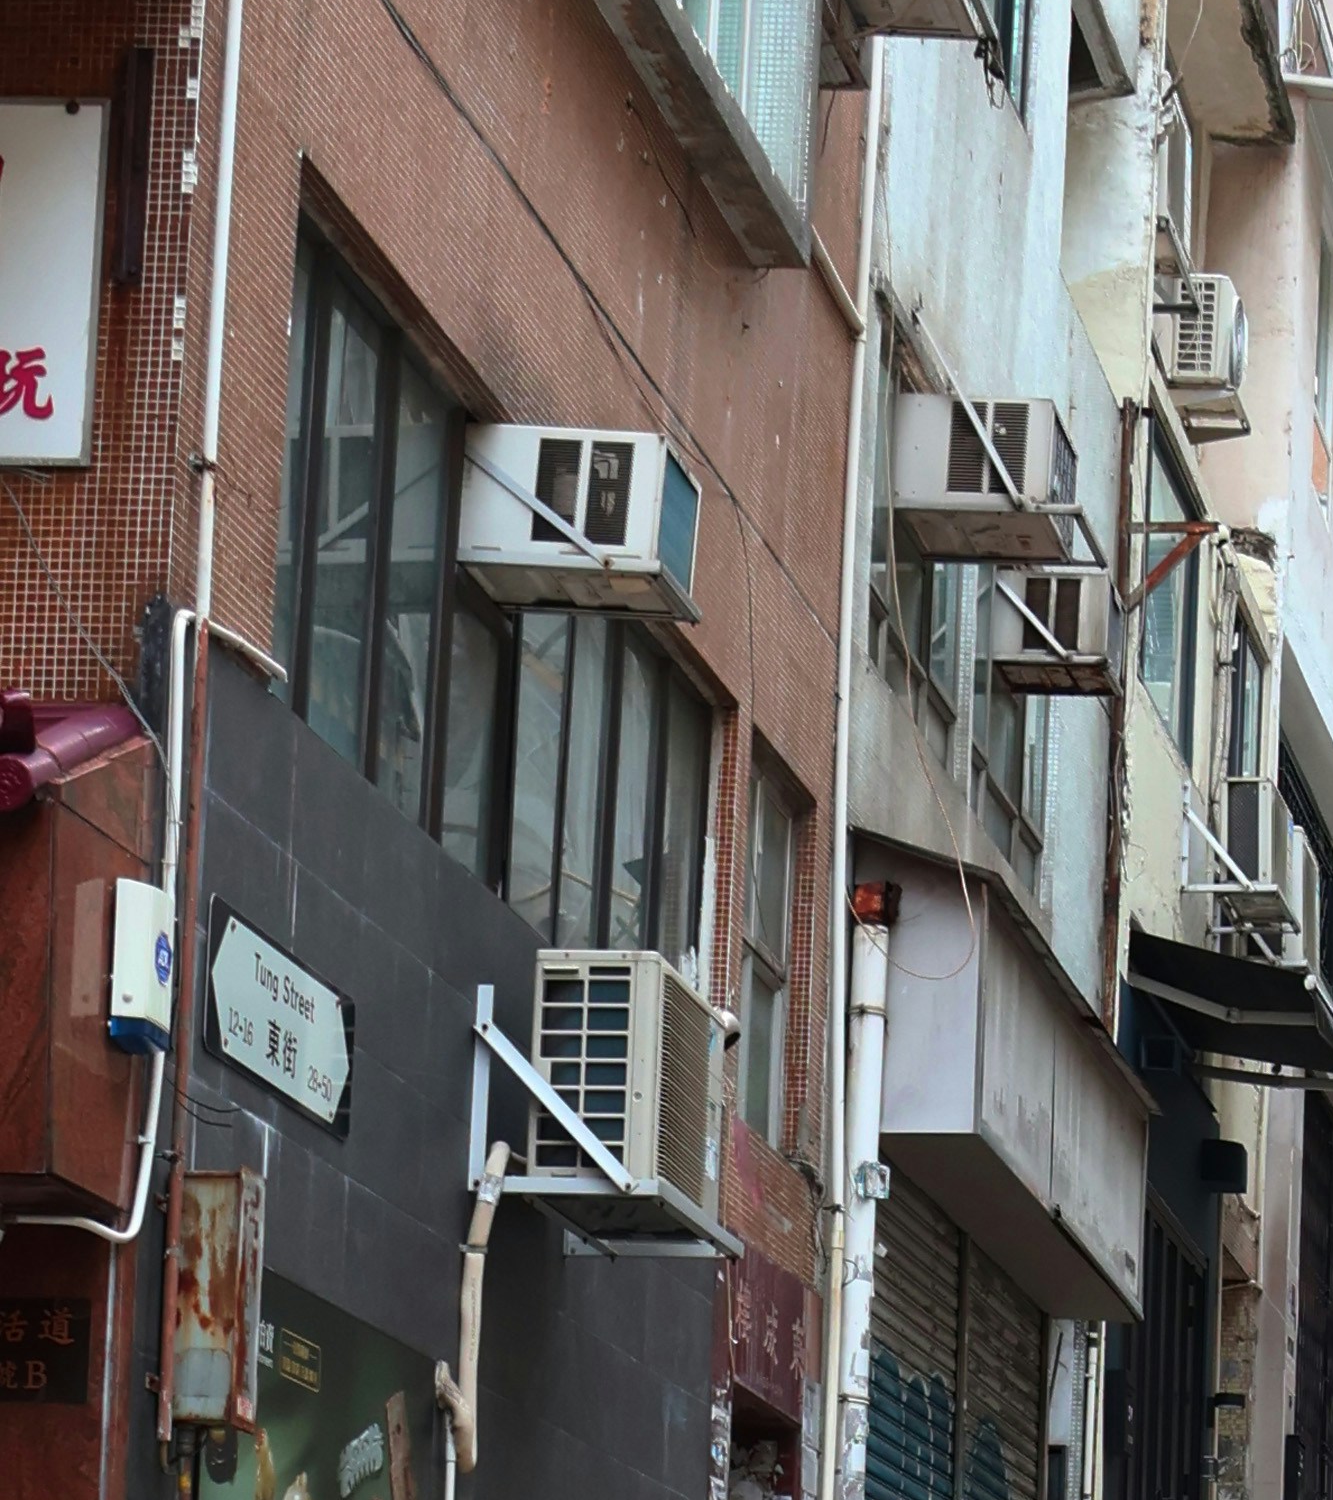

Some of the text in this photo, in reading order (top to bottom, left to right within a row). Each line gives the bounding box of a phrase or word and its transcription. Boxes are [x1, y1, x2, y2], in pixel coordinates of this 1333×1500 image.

[254, 952, 315, 1024] Tung Street
[266, 1020, 297, 1079] 東街
